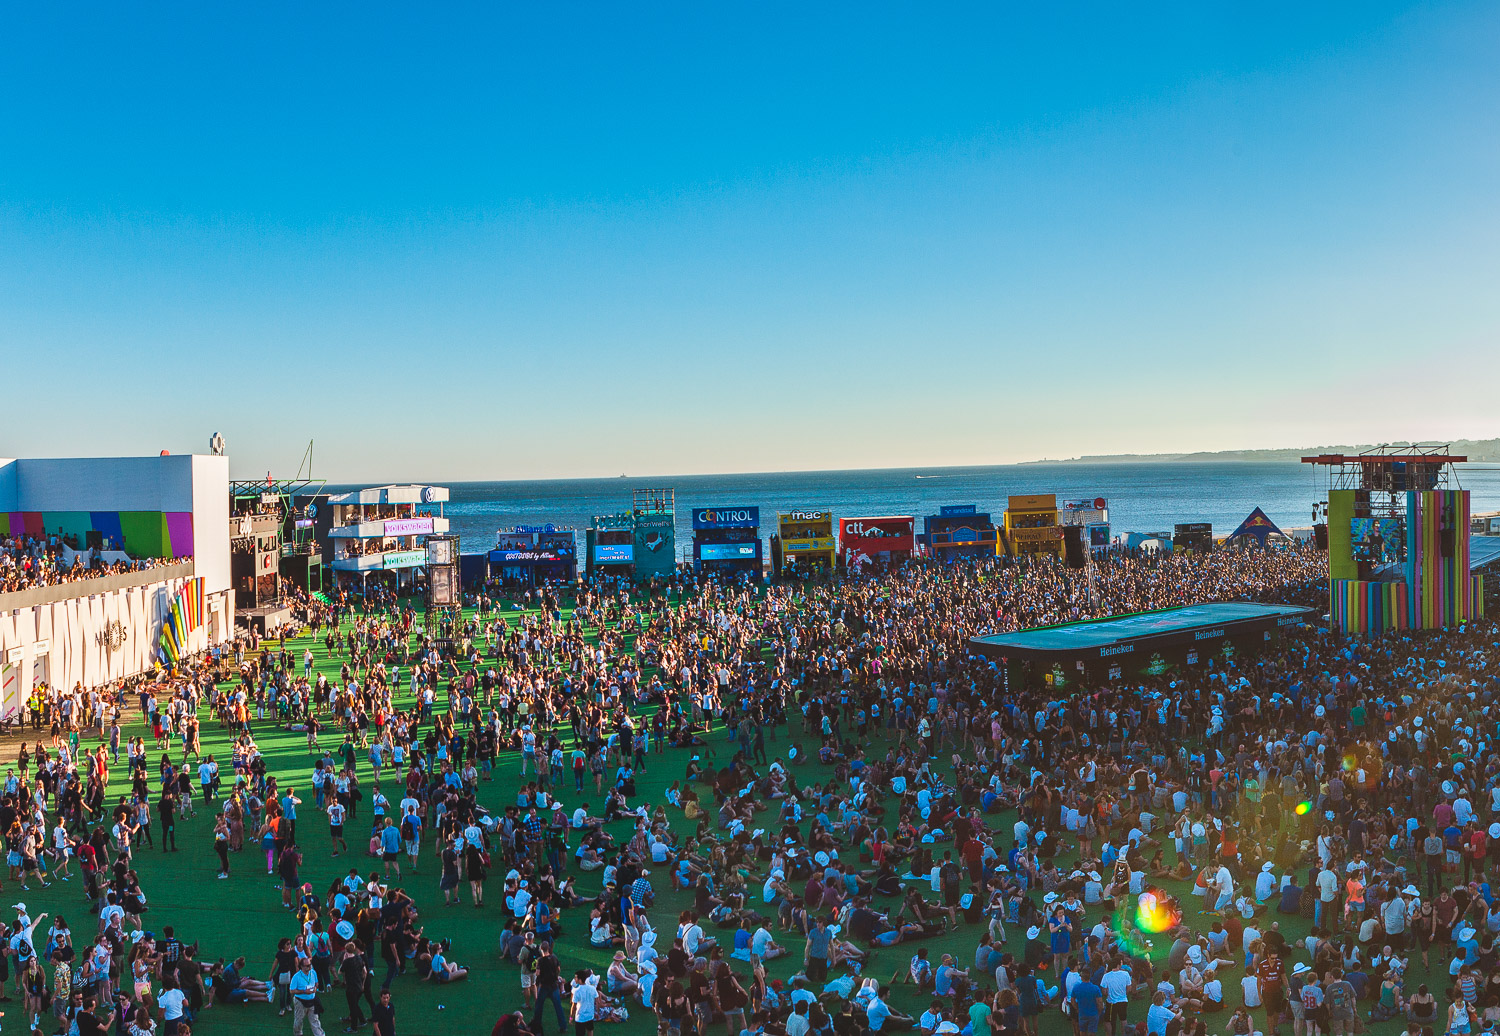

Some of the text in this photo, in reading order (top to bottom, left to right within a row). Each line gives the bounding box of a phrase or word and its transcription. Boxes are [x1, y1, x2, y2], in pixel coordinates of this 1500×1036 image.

[698, 510, 753, 523] CONTROL
[791, 509, 821, 520] fnac
[515, 525, 544, 533] Allianz
[845, 522, 864, 534] ctt
[1277, 616, 1303, 627] Heineken
[1195, 628, 1225, 641] Heineken
[1100, 645, 1134, 657] Heineken
